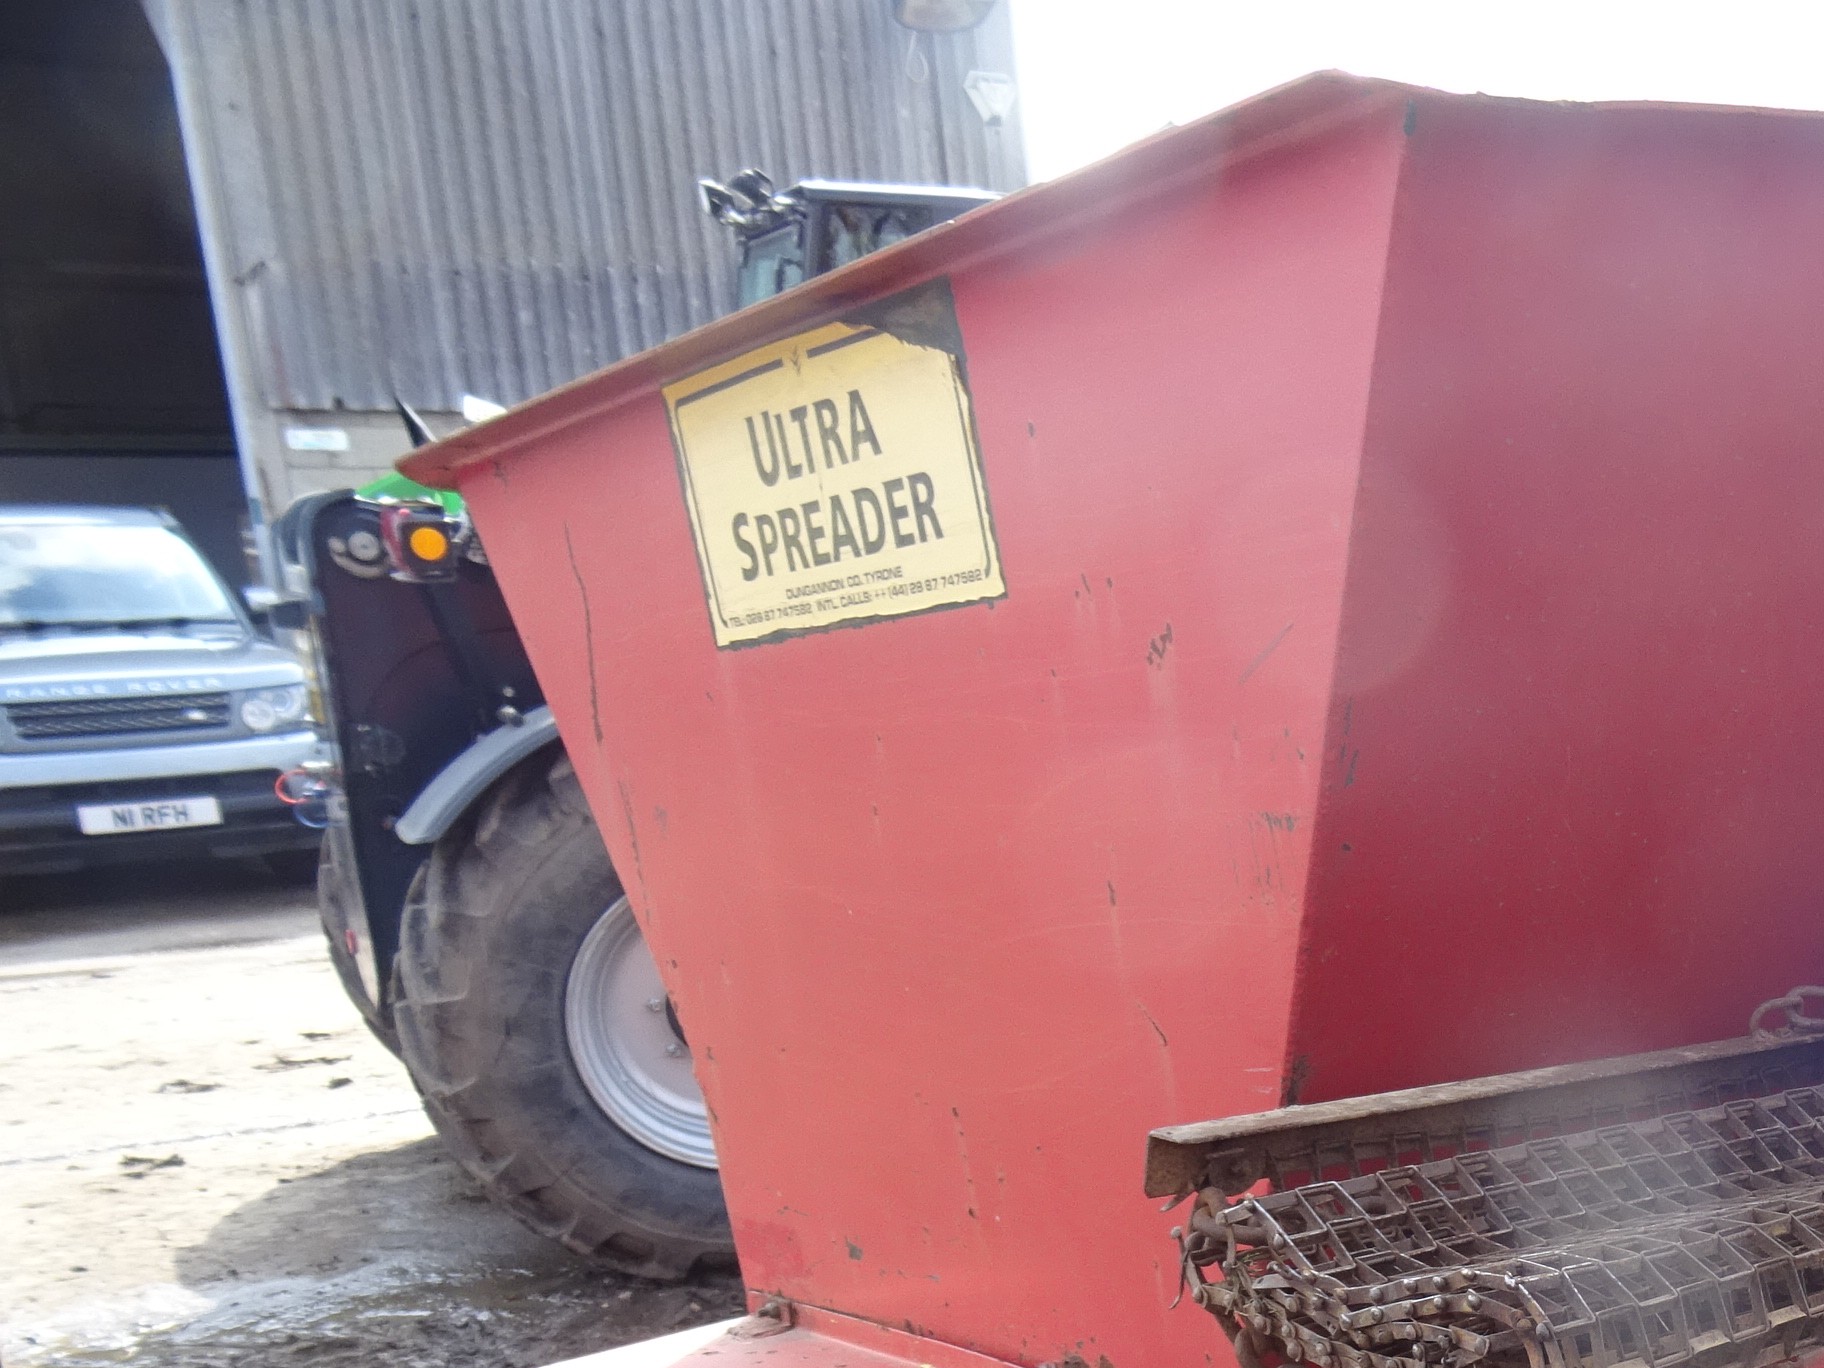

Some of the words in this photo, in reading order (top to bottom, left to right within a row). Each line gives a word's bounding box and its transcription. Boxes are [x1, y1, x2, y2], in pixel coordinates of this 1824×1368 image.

[745, 389, 882, 487] ULTRA
[731, 471, 944, 582] SPREADER
[785, 579, 845, 599] DUNGANNON
[864, 566, 903, 583] TYRONE
[940, 568, 983, 588] 747582
